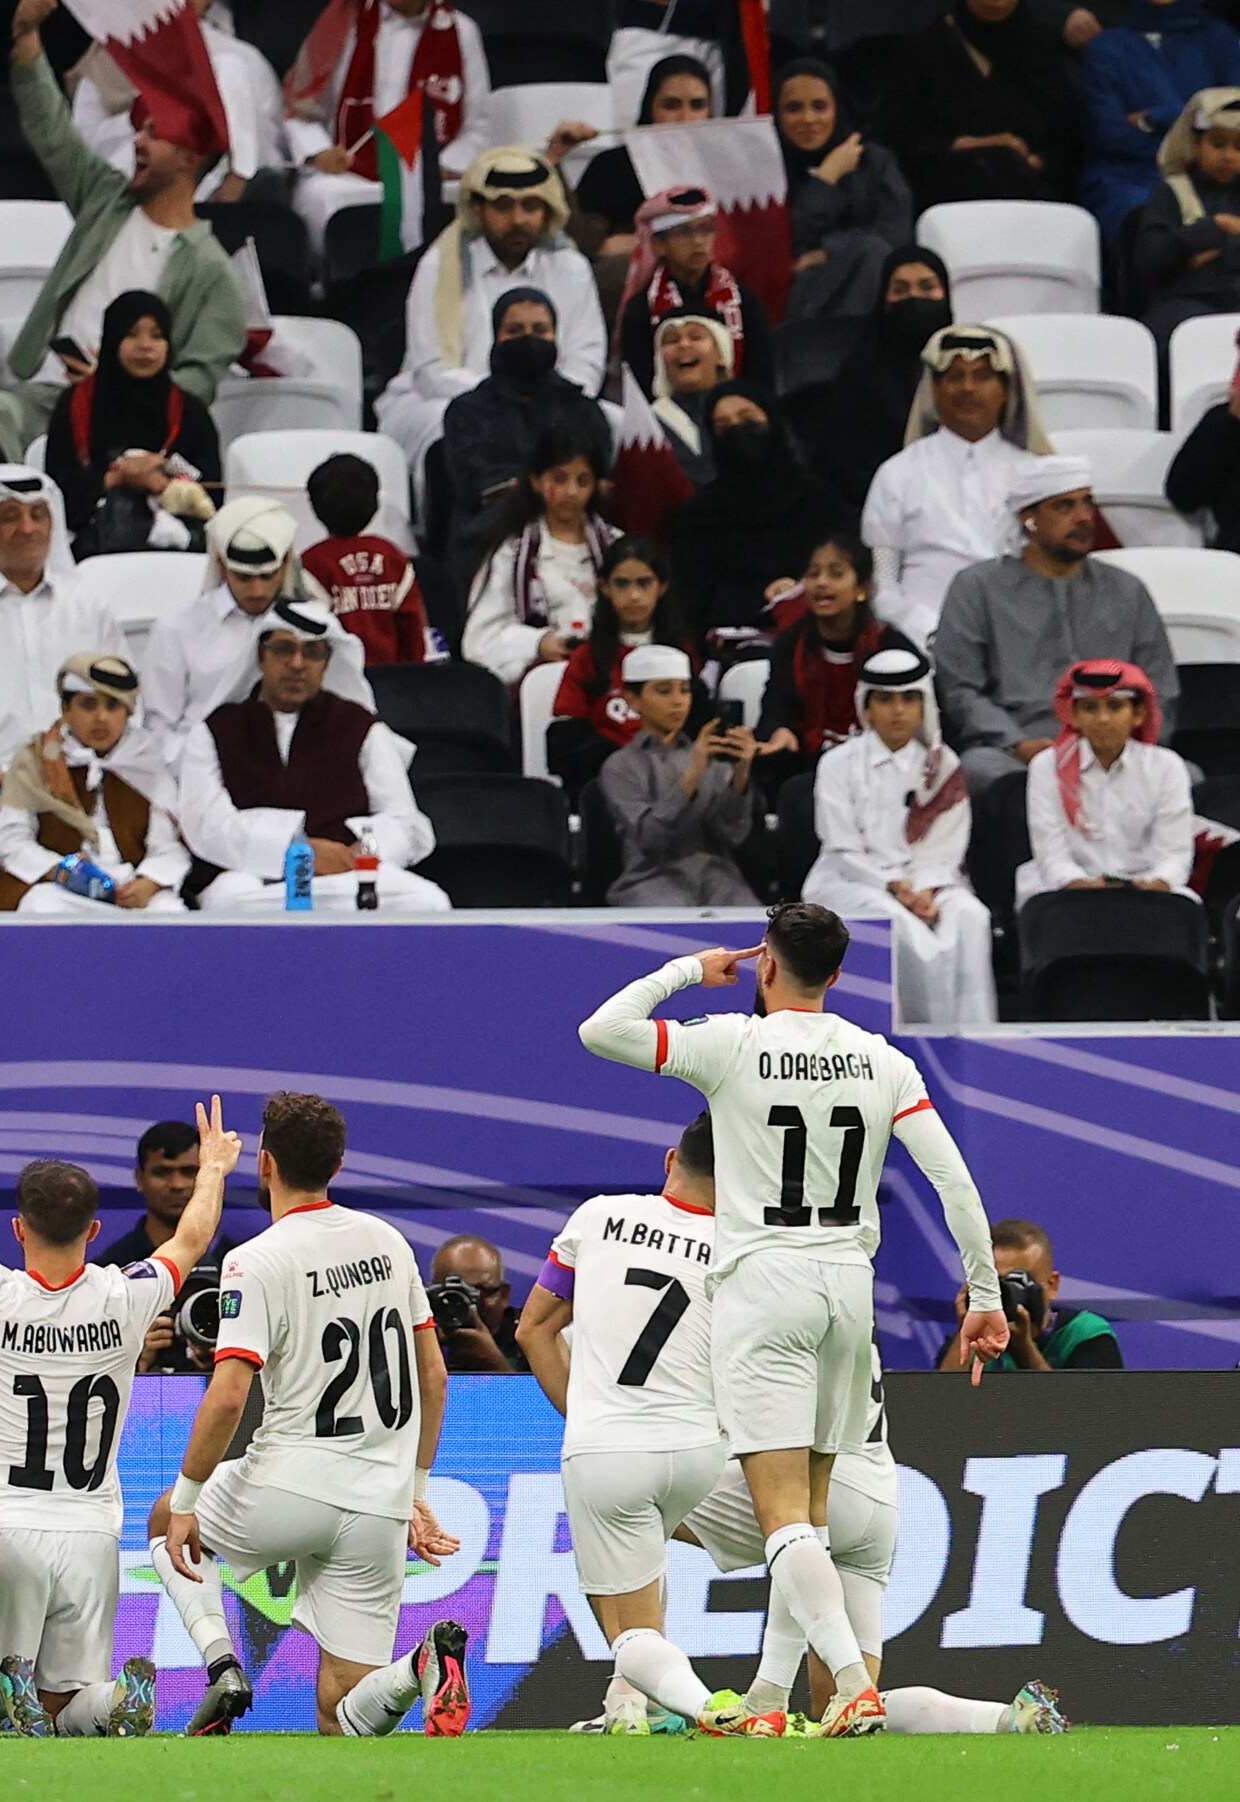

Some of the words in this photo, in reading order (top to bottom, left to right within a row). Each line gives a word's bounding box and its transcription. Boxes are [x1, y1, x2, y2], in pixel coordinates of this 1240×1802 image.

[759, 1052, 874, 1081] O.DABBAGH
[764, 1105, 866, 1227] 11
[306, 1255, 392, 1298] Z.QUNBAR
[617, 1268, 691, 1386] 7
[1, 1319, 122, 1353] M.ABUWARDA
[315, 1306, 413, 1437] 20
[8, 1374, 120, 1491] 10
[392, 1448, 1240, 1663] PREDIC
